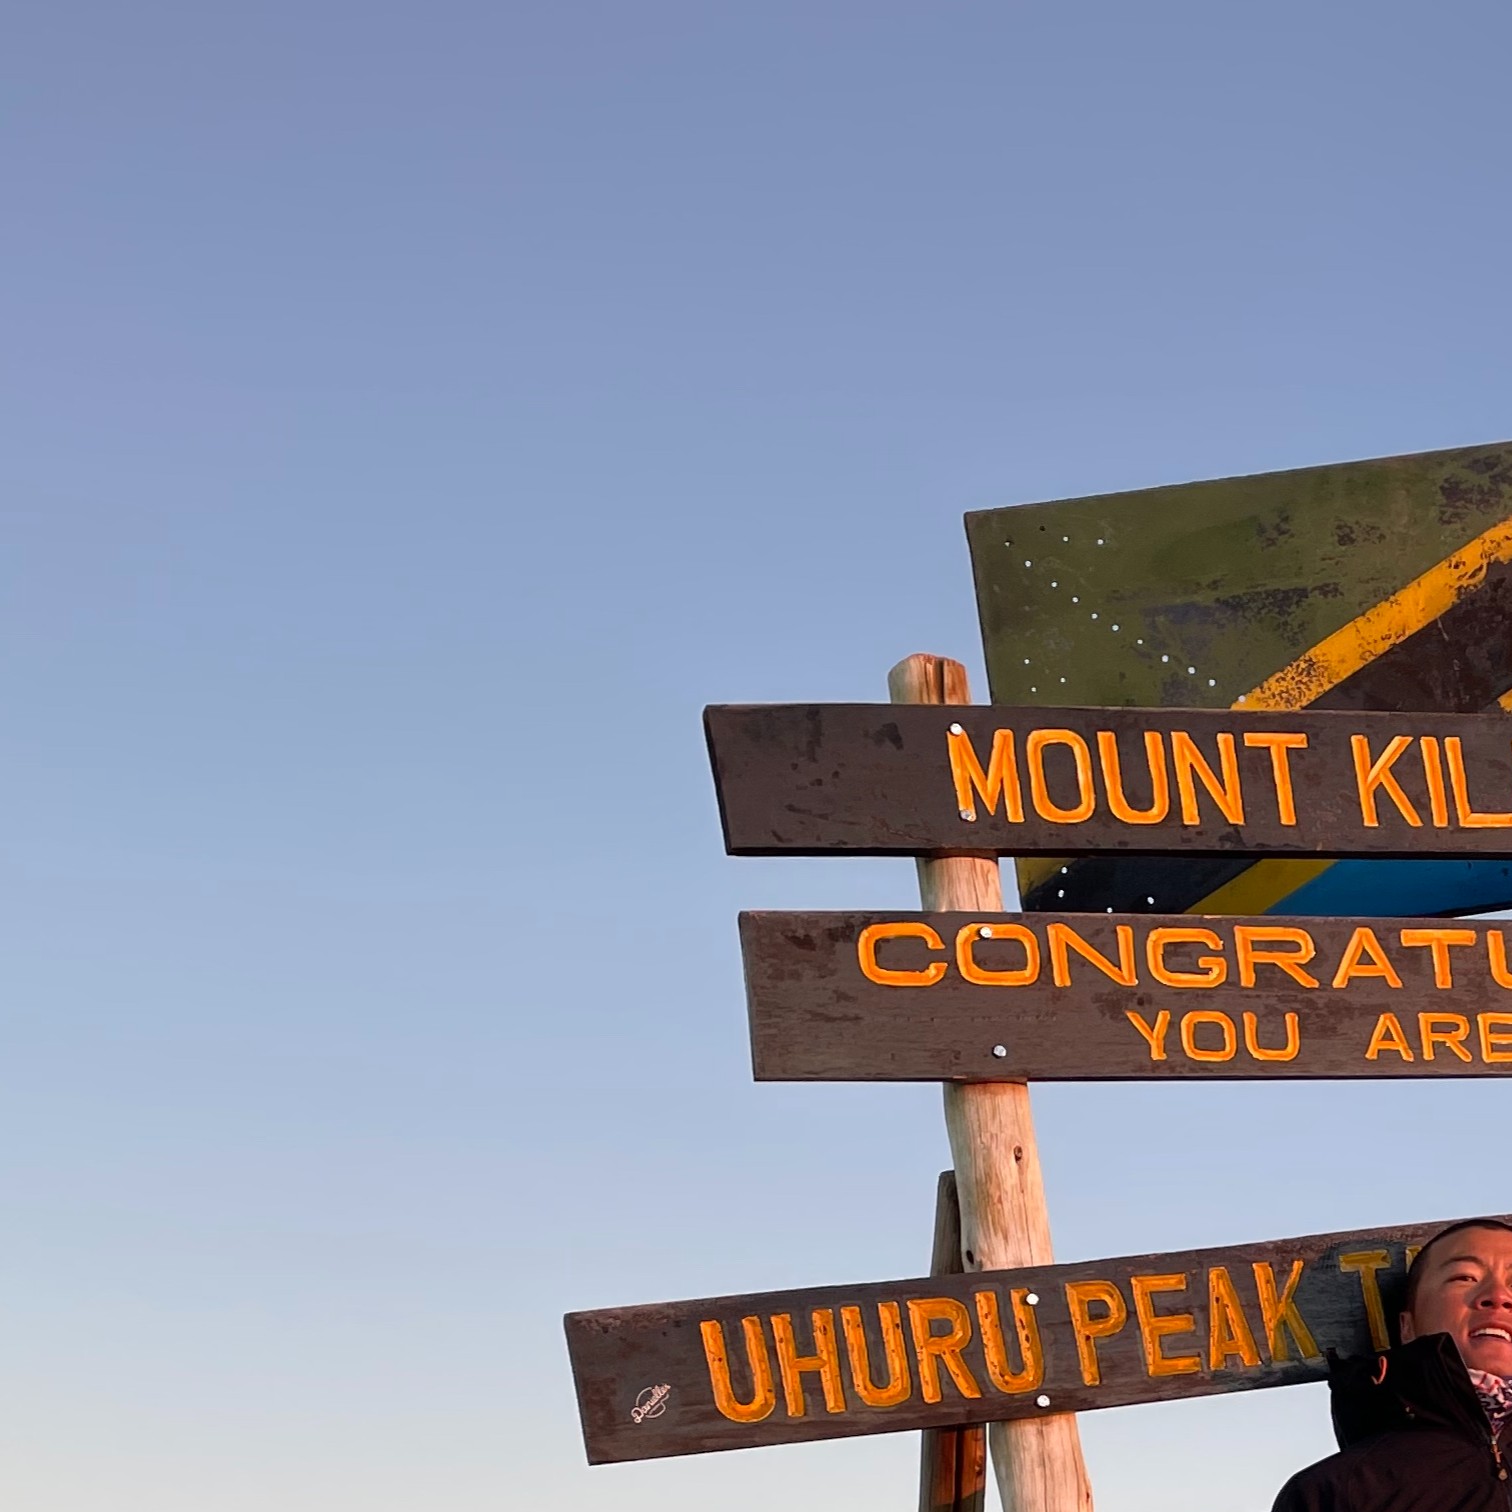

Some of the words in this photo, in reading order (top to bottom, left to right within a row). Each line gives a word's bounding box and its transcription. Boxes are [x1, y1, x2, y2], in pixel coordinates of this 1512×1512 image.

[947, 728, 1309, 827] MOUNT
[1125, 1010, 1299, 1062] YOU
[700, 1287, 1046, 1423] UHURU
[1065, 1259, 1322, 1387] PEAK
